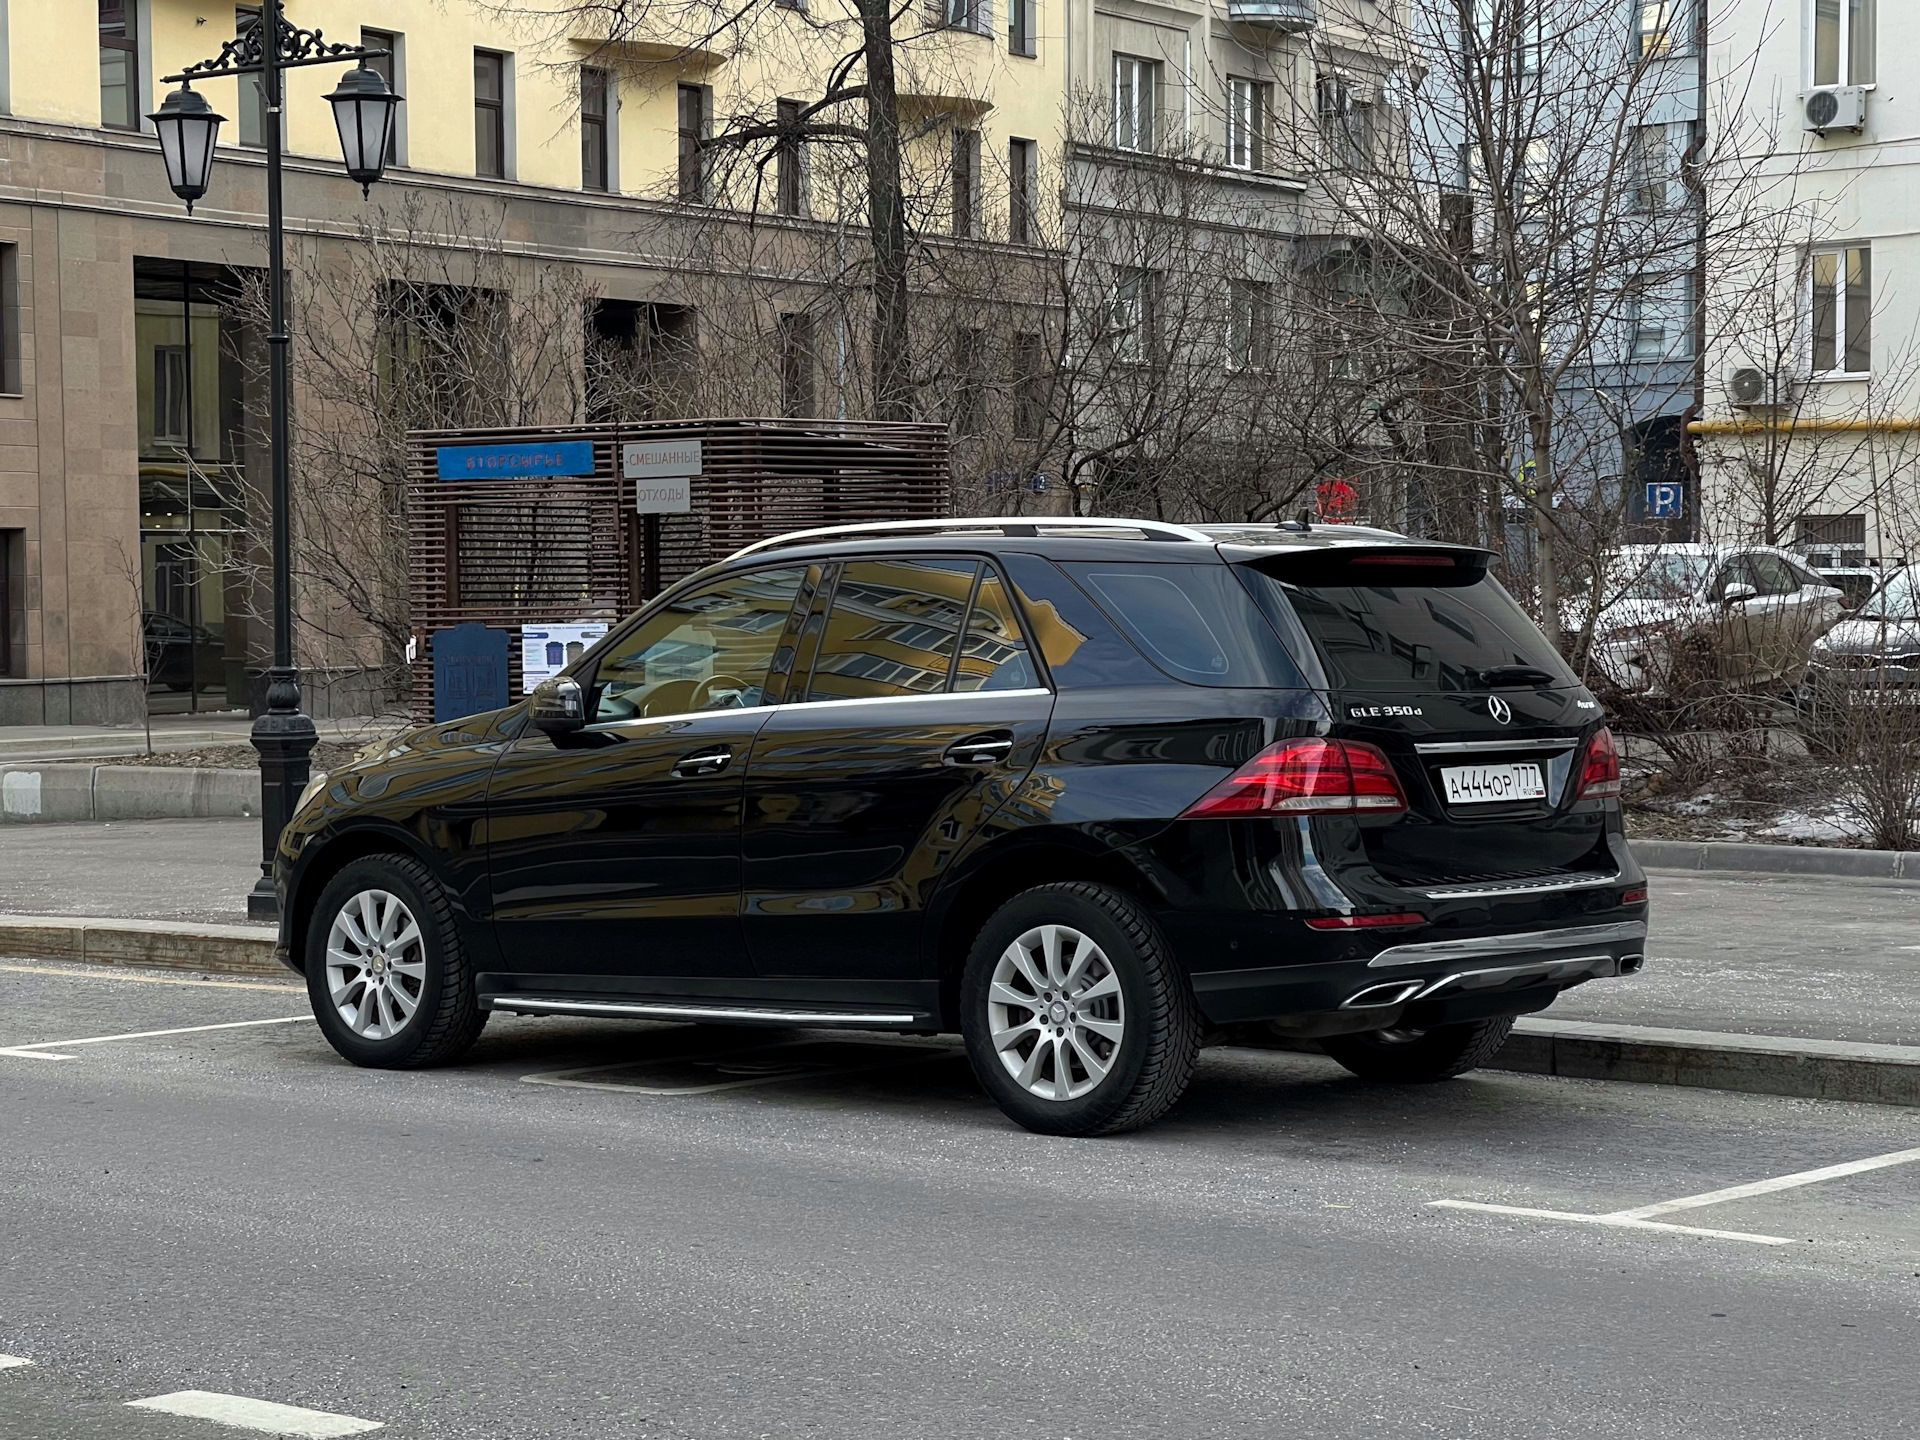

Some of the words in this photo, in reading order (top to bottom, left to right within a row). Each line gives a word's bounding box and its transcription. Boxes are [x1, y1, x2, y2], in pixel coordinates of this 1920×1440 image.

[465, 452, 564, 470] ВТОРСЫРЬЕ
[629, 450, 700, 467] СМЕШАННЫЕ
[638, 486, 684, 502] ОТХОДЫ
[1656, 486, 1675, 515] P
[1350, 707, 1381, 717] GLE
[1382, 705, 1423, 716] 350d
[1513, 766, 1537, 787] 777
[1523, 788, 1536, 796] RUS
